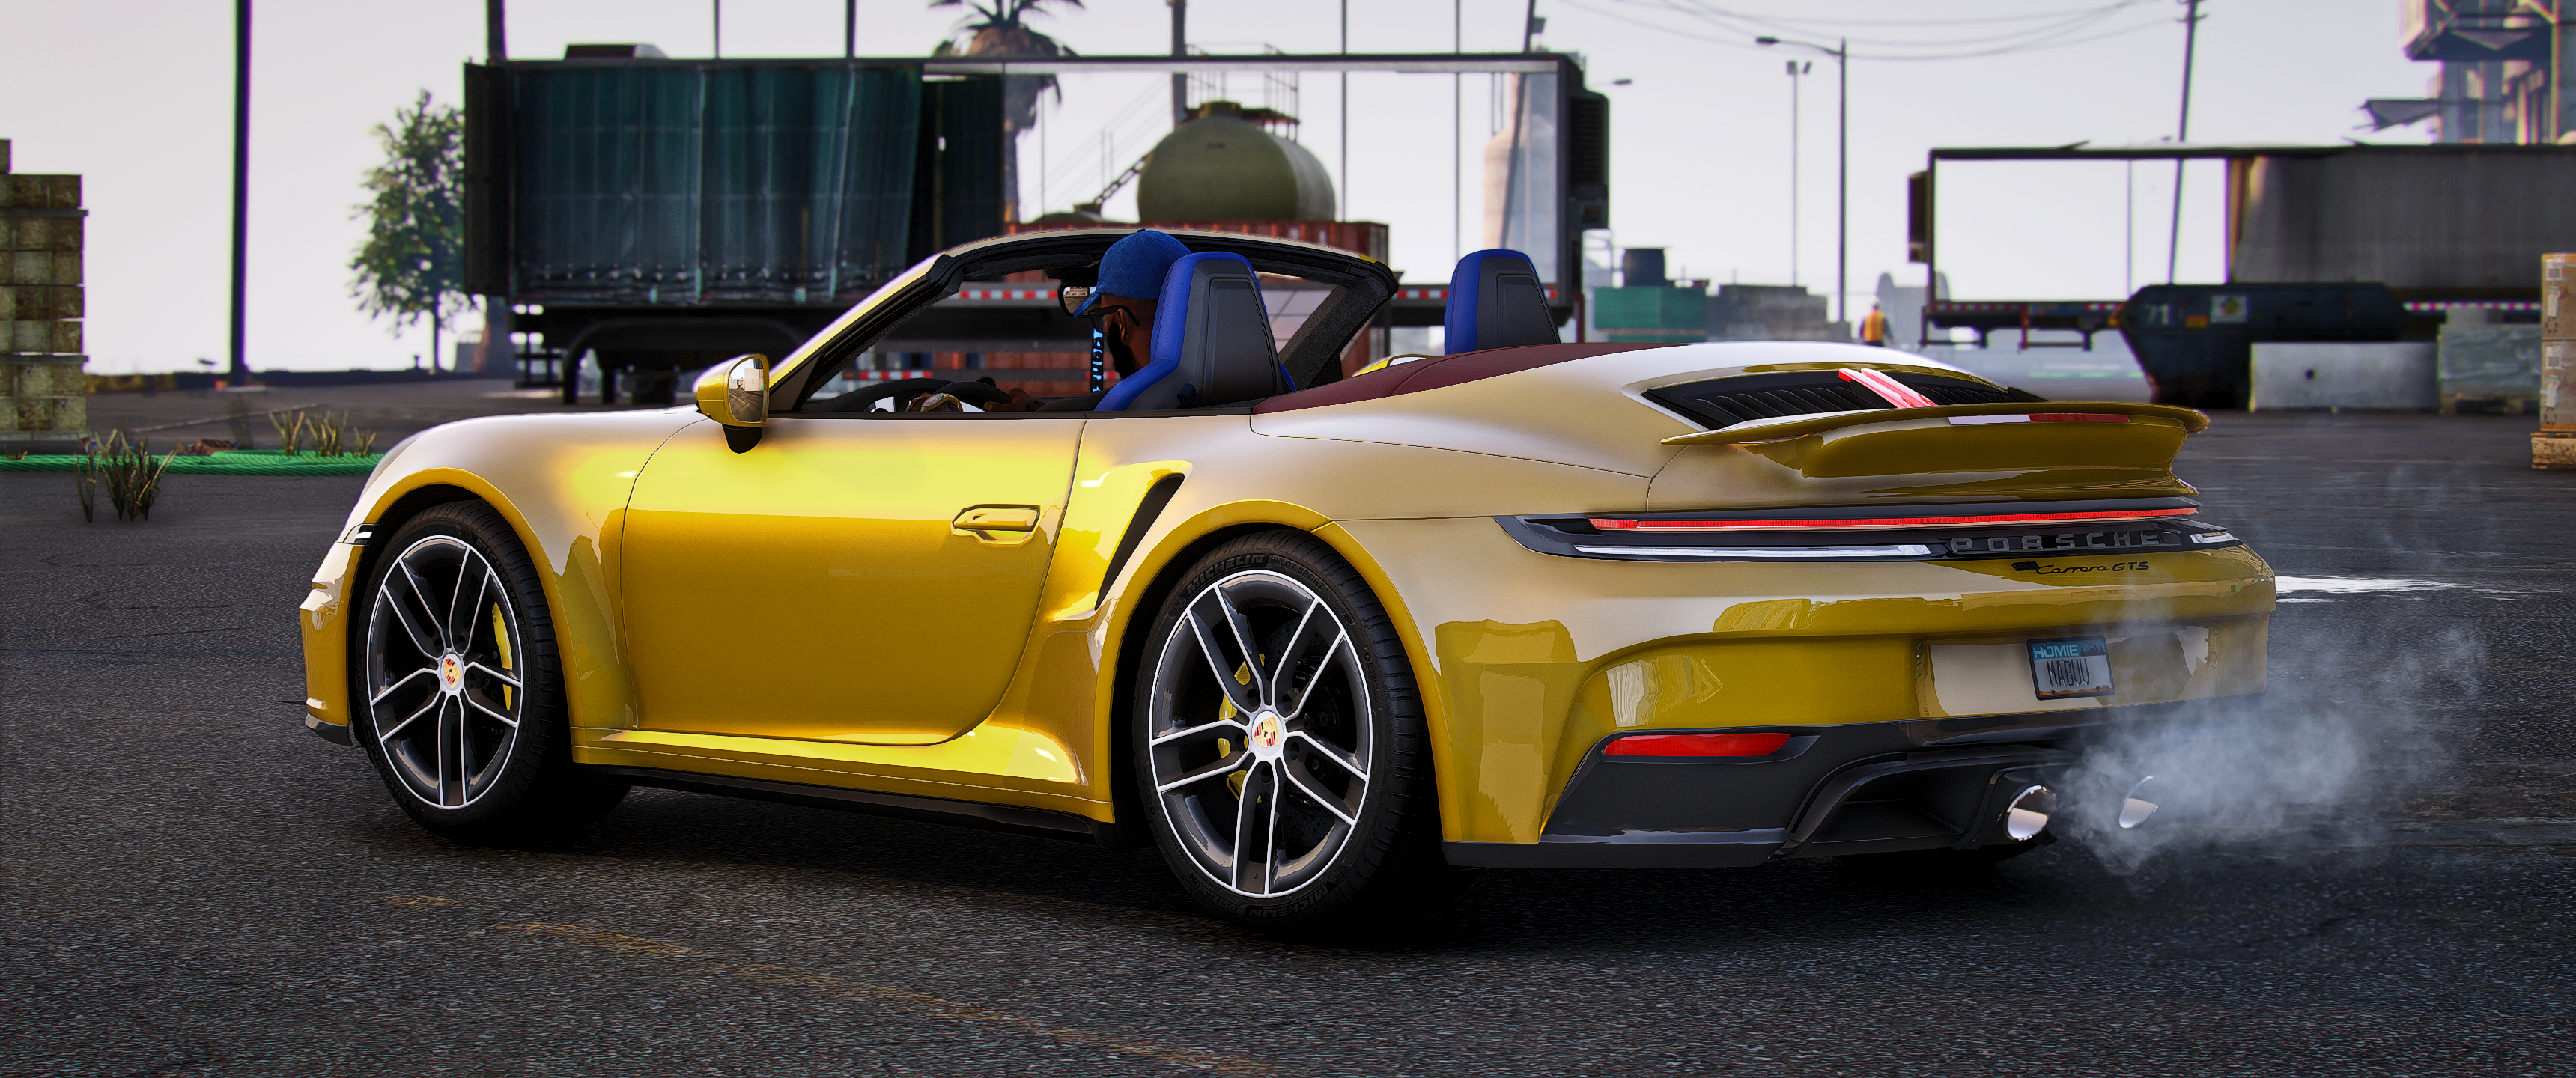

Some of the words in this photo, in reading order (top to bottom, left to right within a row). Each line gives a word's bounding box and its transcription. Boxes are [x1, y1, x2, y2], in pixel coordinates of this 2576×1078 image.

[1951, 532, 2160, 552] PORSCHE
[476, 538, 522, 614] MICHELIN
[1187, 554, 1265, 594] MICHELIN
[1272, 557, 1297, 570] PILOT
[1298, 566, 1325, 588] SPORT
[2036, 564, 2110, 575] Carrera
[2112, 561, 2151, 571] GTS
[2033, 645, 2079, 659] HOMIE
[367, 728, 408, 805] MICHELIN
[1249, 883, 1329, 919] MICHELIN
